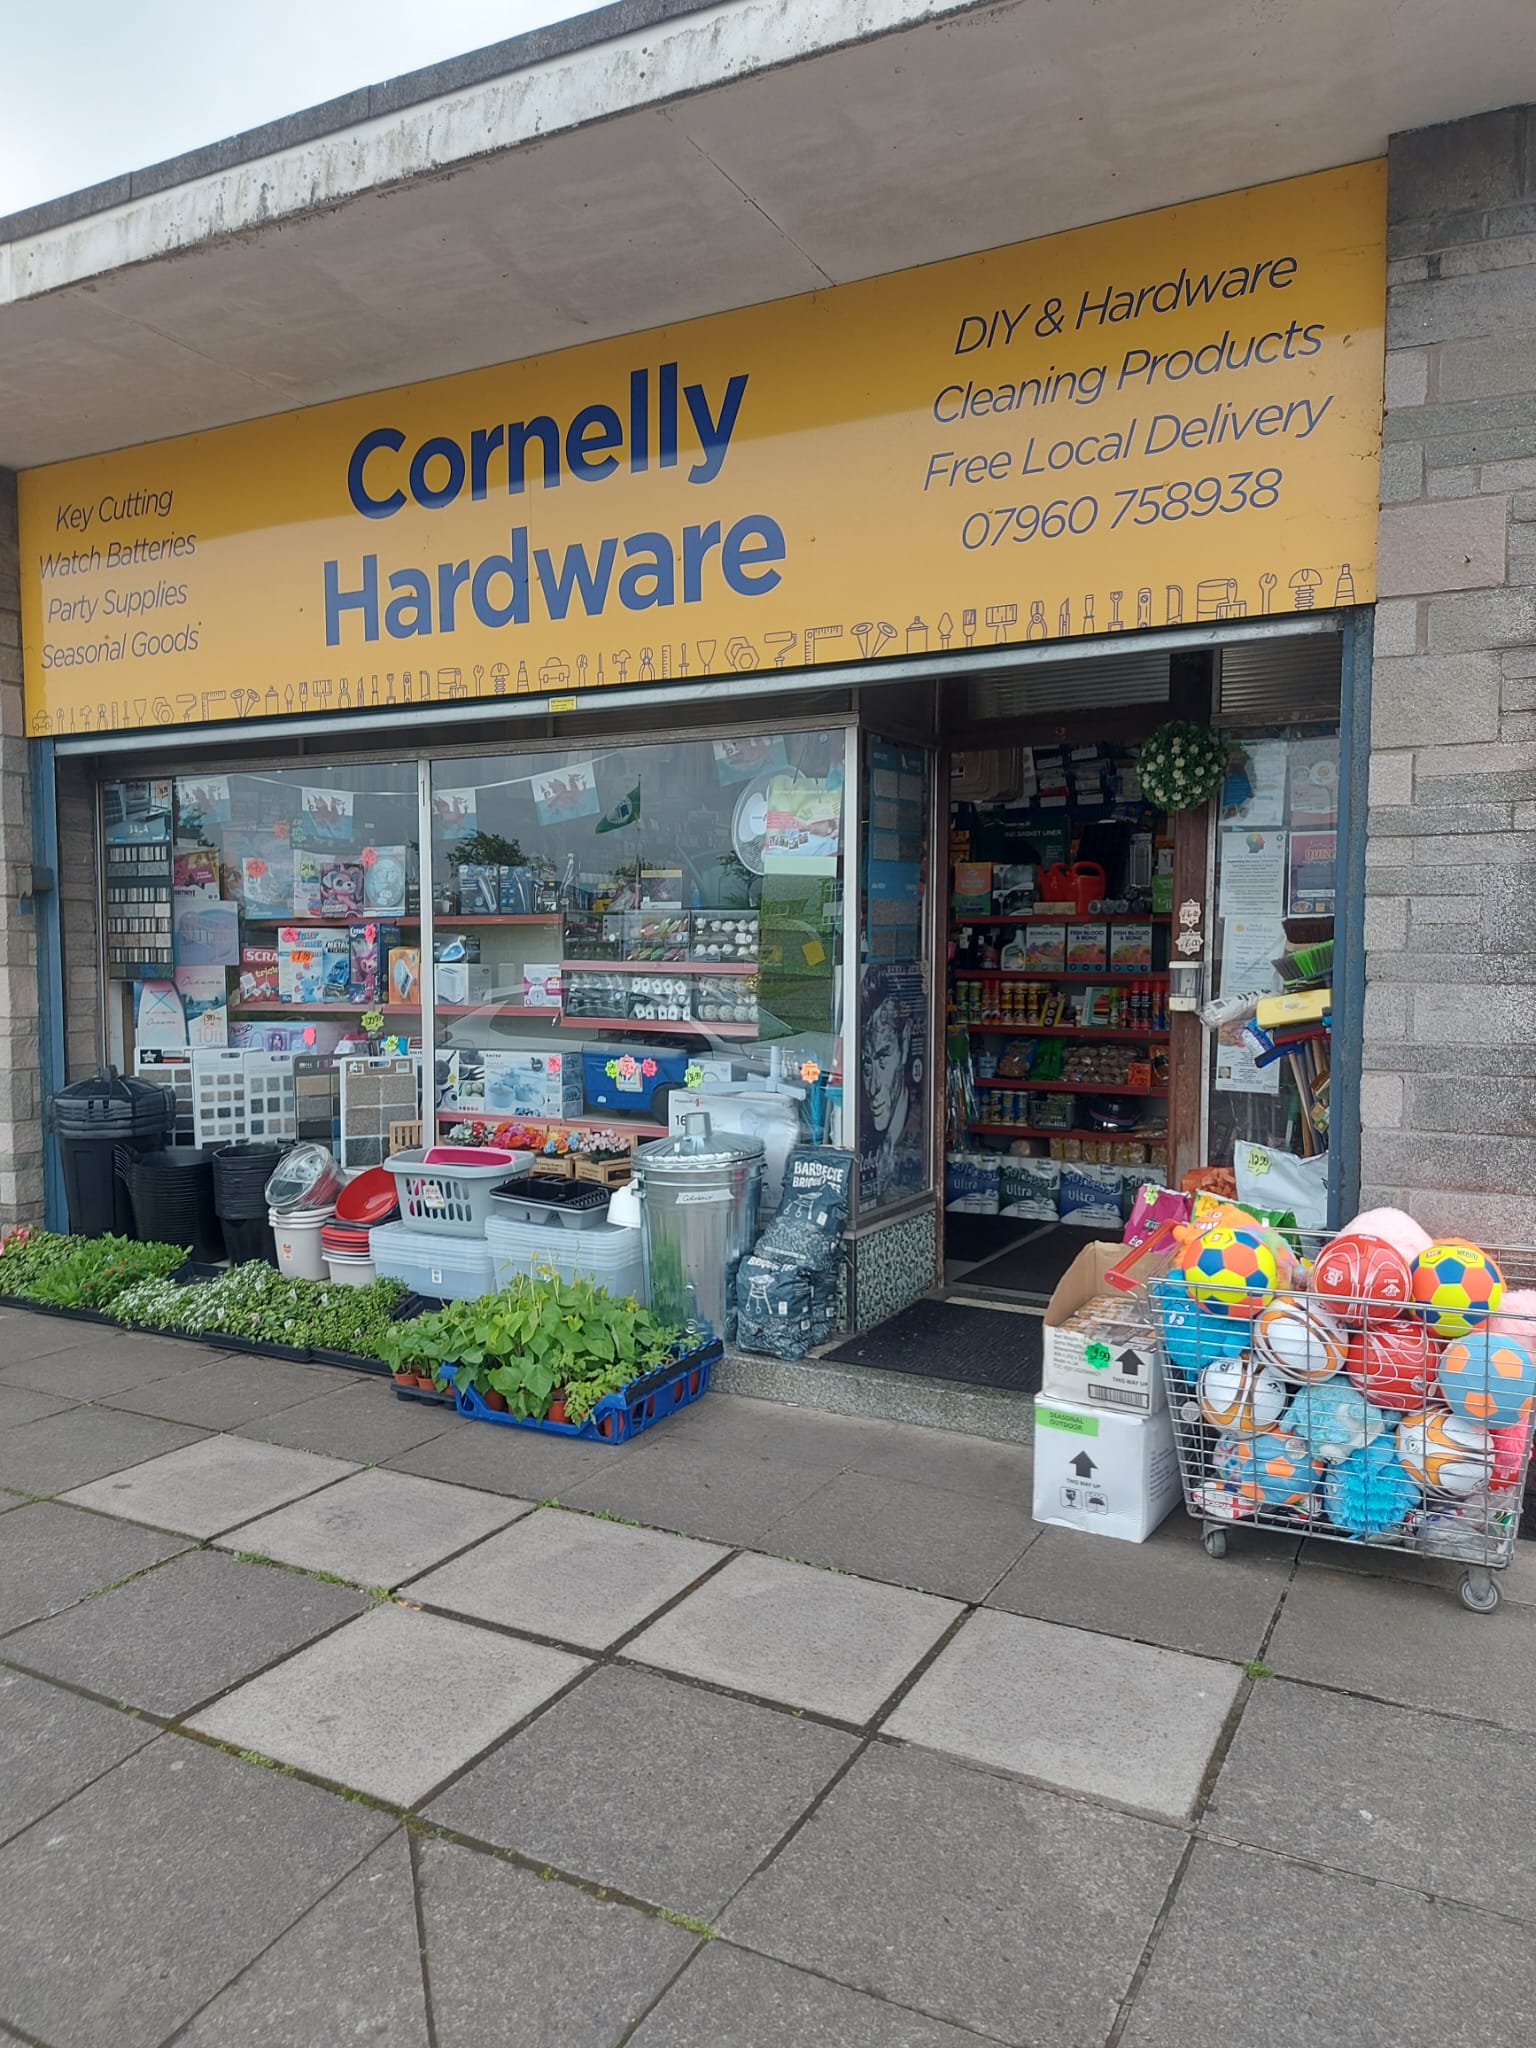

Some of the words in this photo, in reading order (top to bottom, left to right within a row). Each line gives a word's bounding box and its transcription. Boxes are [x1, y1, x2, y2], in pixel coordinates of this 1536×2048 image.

[954, 304, 1030, 355] DIY
[1034, 297, 1064, 338] &
[1075, 255, 1298, 330] Hardware
[932, 364, 1107, 424] Cleaning
[1117, 319, 1325, 391] Products
[347, 361, 749, 519] Cornelly
[922, 450, 1012, 491] Free
[1022, 418, 1137, 475] Local
[1144, 393, 1335, 456] Delivery
[56, 504, 94, 532] Key
[98, 488, 174, 524] Cutting
[961, 495, 1099, 551] 07960
[1110, 467, 1283, 530] 758938
[39, 546, 101, 580] Watch
[106, 531, 197, 569] Batteries
[47, 594, 99, 625] Party
[102, 580, 188, 618] Supplies
[324, 515, 787, 647] Hardware
[40, 633, 126, 670] Seasonal
[131, 624, 200, 658] Goods
[1006, 1184, 1032, 1197] Ultra
[1067, 1190, 1096, 1202] Ultra
[1112, 1376, 1126, 1385] THIS
[1126, 1378, 1139, 1386] WAY
[1049, 1411, 1084, 1425] SEASONAL
[1049, 1418, 1083, 1431] OUTDOOR
[1066, 1478, 1079, 1486] THIS
[1079, 1480, 1092, 1488] WAY
